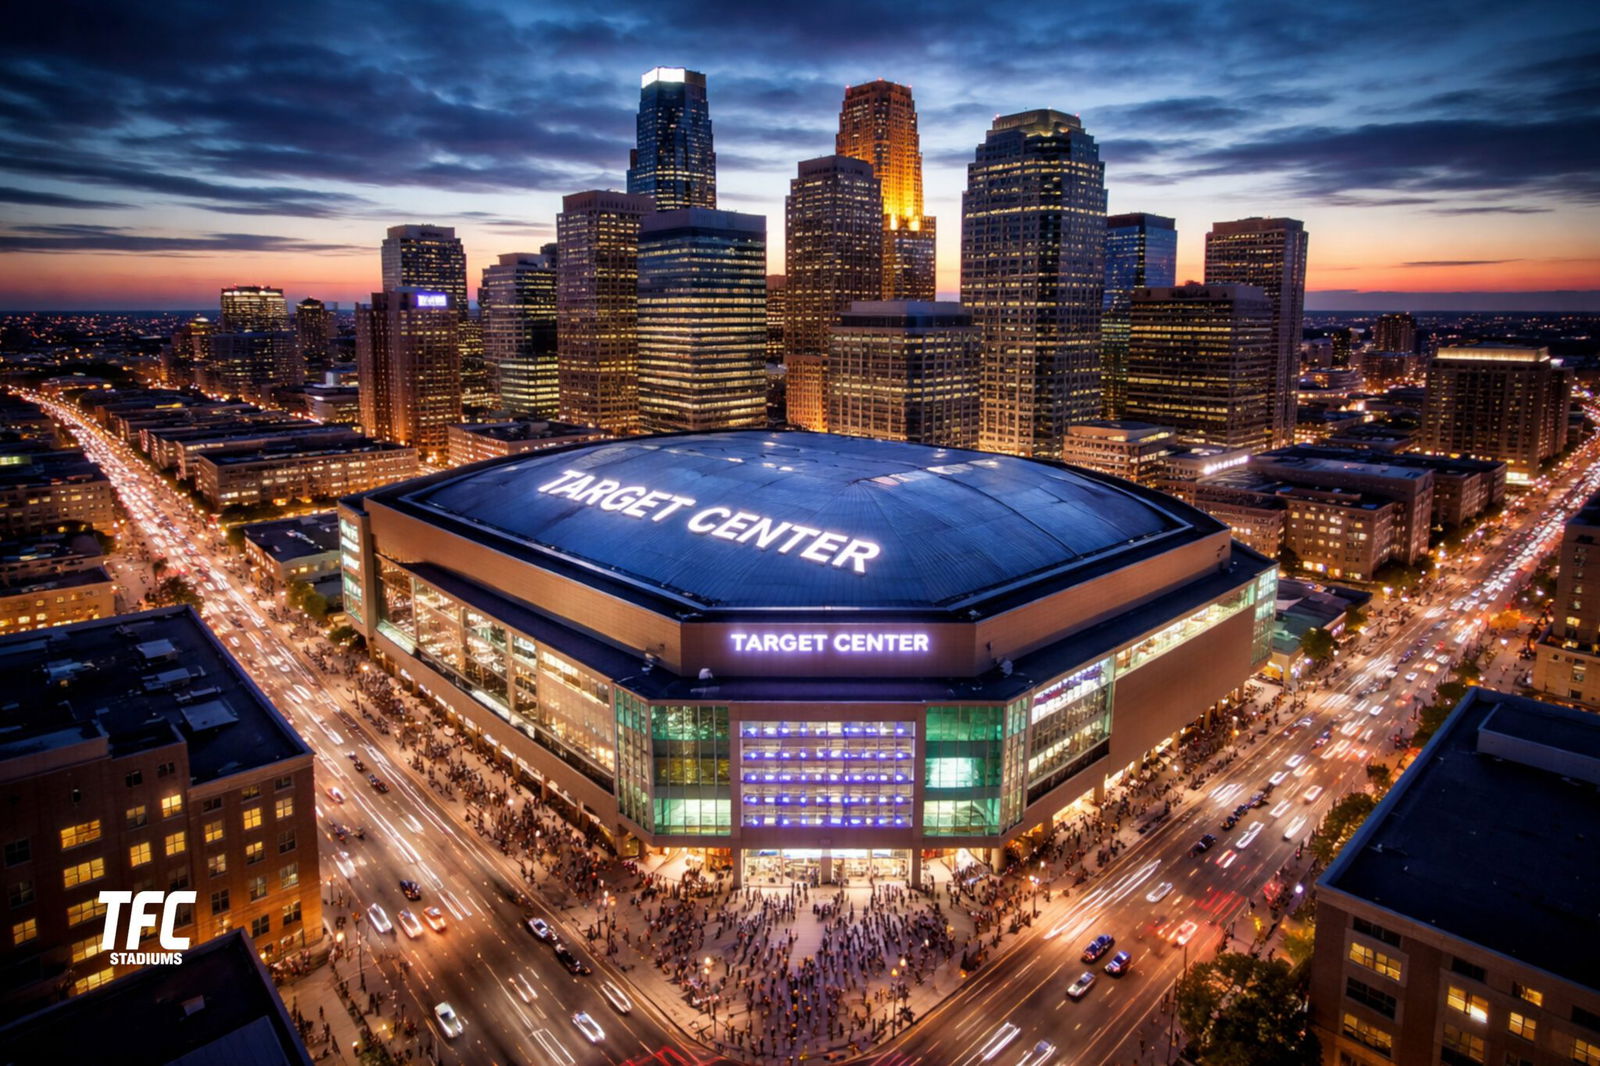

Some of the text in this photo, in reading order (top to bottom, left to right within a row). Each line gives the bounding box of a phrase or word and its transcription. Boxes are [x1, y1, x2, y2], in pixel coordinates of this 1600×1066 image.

[537, 469, 881, 573] TARGET CENTER
[730, 633, 929, 652] TARGET CENTER
